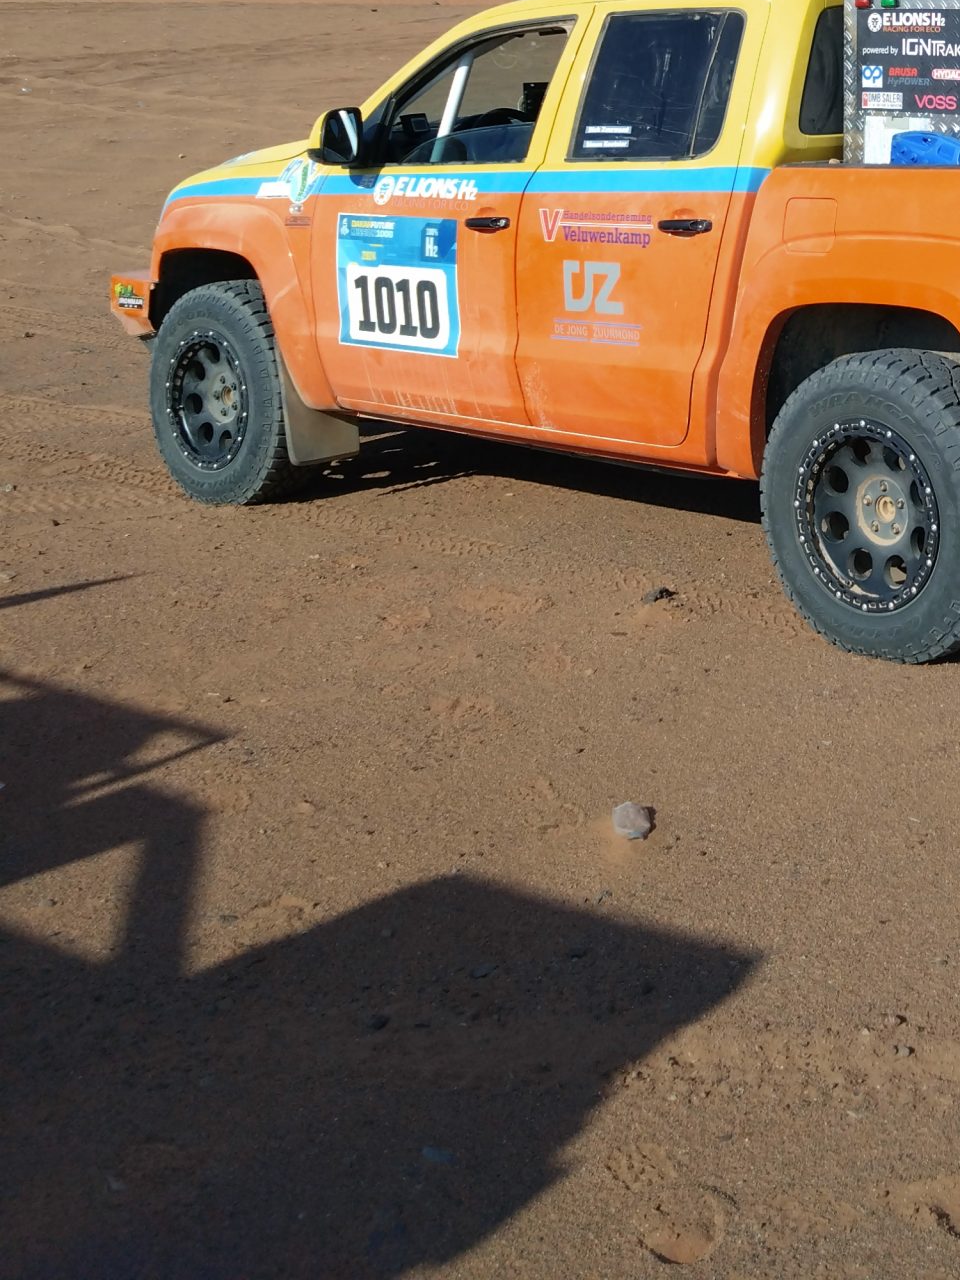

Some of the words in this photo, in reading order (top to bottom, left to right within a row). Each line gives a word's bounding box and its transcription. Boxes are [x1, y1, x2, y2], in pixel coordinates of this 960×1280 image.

[862, 45, 889, 56] powered
[890, 45, 899, 56] by
[914, 94, 958, 110] VOSS
[563, 225, 651, 248] Veluwenkamp
[354, 275, 440, 339] 1010
[554, 323, 565, 334] DE
[566, 324, 588, 336] JONG
[592, 325, 640, 340] ZUURMOND
